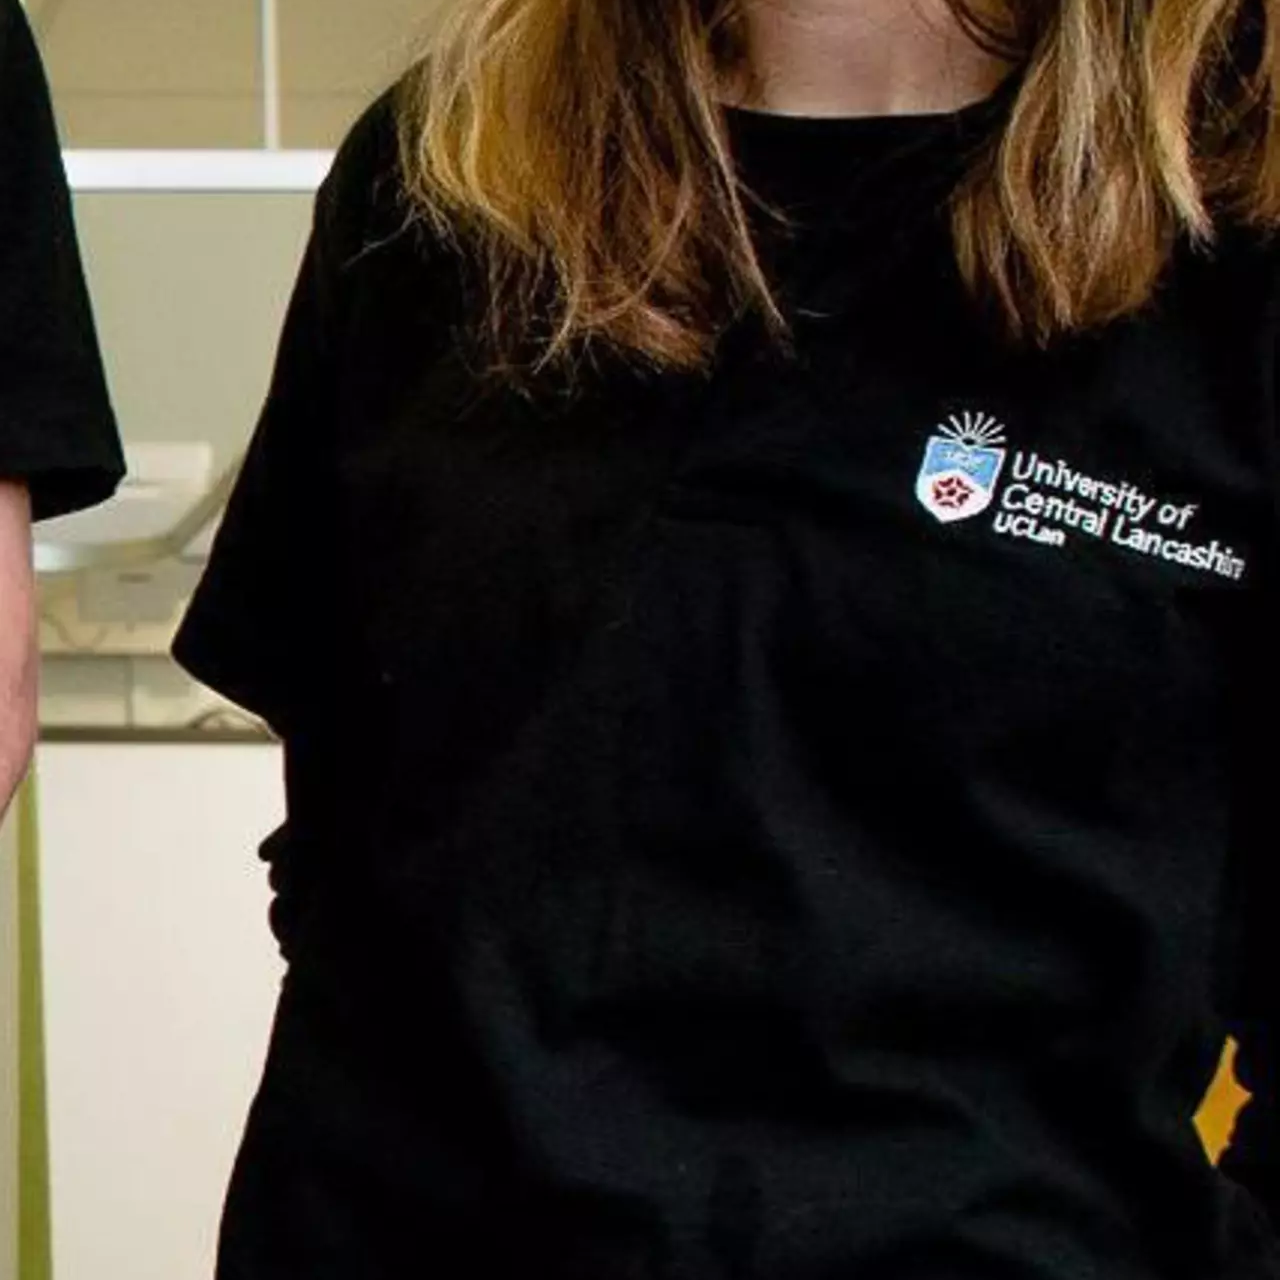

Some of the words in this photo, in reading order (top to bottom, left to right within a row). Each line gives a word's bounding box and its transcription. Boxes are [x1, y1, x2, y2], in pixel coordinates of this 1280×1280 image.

[992, 512, 1066, 547] UCLan
[1011, 451, 1158, 522] University
[1158, 503, 1200, 531] of
[1001, 483, 1109, 536] Central
[1111, 514, 1246, 580] Lancashir
